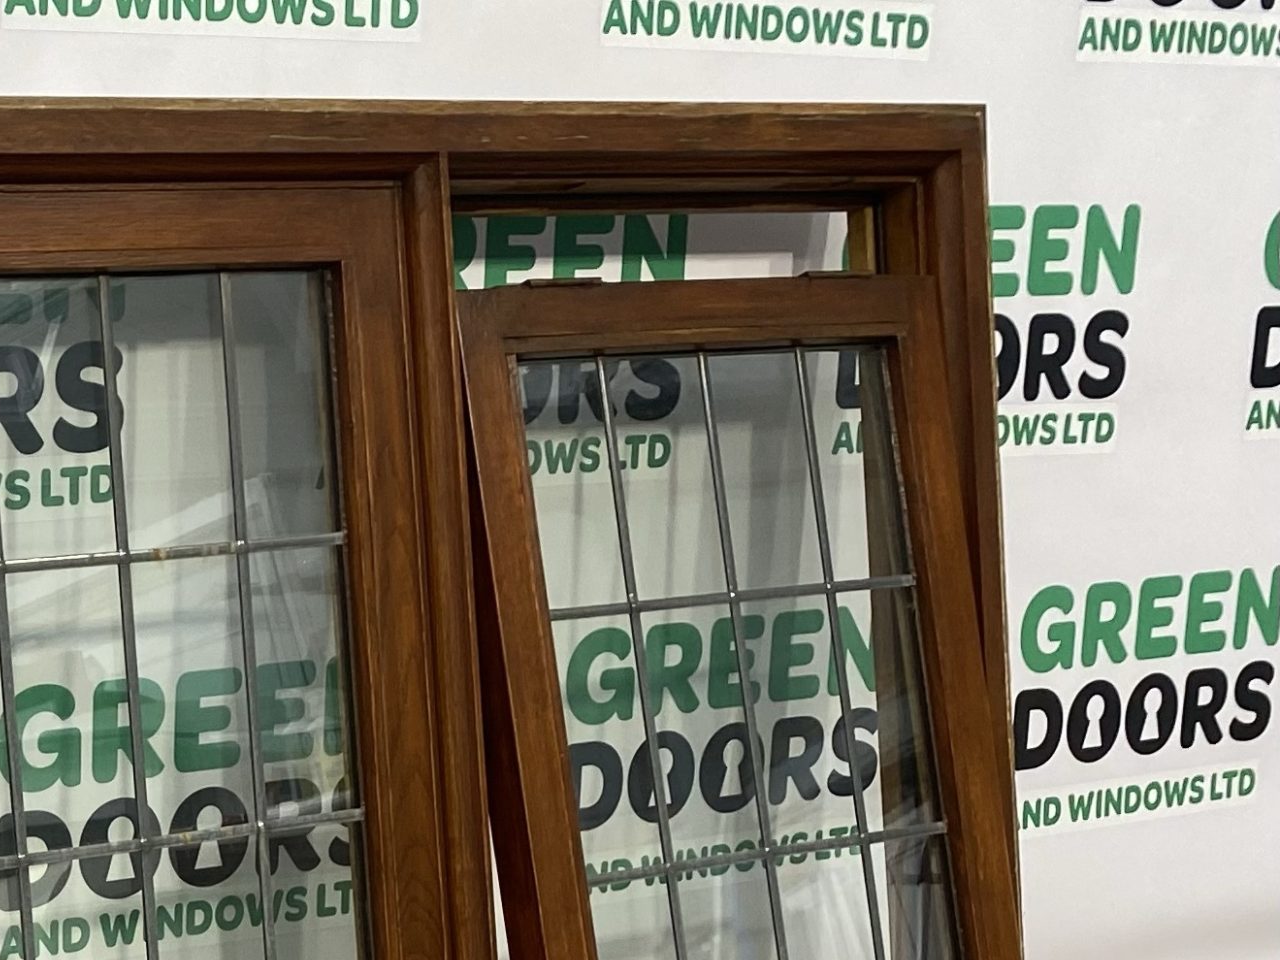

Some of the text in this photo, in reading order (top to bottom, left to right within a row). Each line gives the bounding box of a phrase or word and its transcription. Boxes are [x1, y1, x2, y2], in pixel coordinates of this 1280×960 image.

[603, 0, 929, 49] AND WINDOWS LTD
[1078, 17, 1280, 56] AND WINDOW
[989, 204, 1142, 297] EEN
[1063, 412, 1115, 445] LTD
[1021, 565, 1280, 674] GREEN
[1014, 660, 1275, 771] DOORS
[567, 707, 879, 832] DOORS
[1022, 768, 1256, 830] ND WINDOWS LTD
[99, 885, 308, 948] WNDOWS
[316, 880, 353, 918] LT
